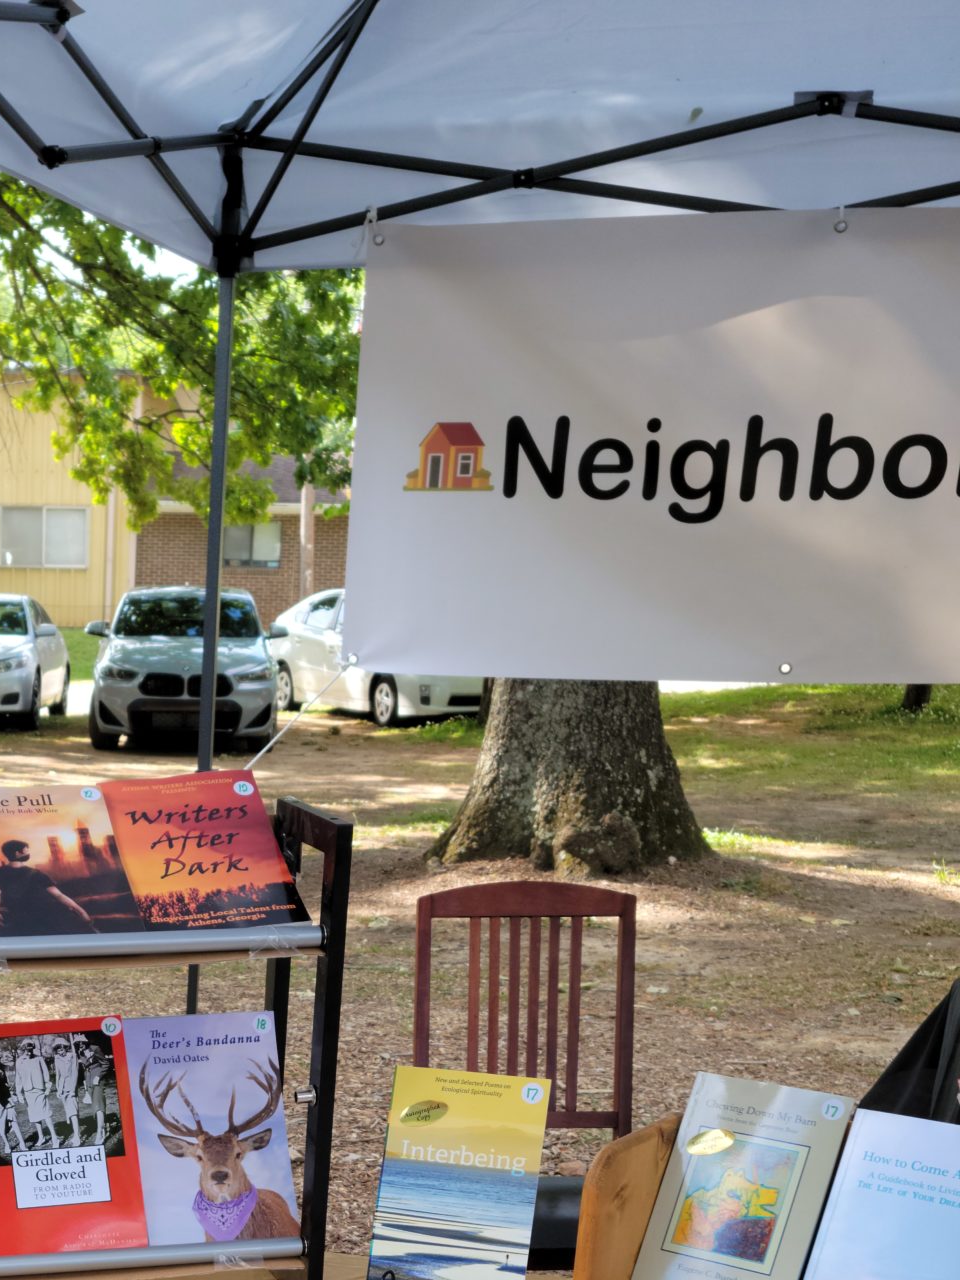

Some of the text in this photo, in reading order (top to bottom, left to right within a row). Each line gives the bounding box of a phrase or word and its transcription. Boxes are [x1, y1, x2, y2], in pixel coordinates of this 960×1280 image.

[502, 413, 960, 524] Neighbo
[16, 793, 54, 807] Pull
[124, 804, 249, 825] Writers
[150, 829, 240, 860] After
[160, 853, 249, 879] Dark
[150, 903, 296, 923] Showcasing Local Talent from
[227, 912, 267, 924] Georgia
[104, 1022, 117, 1033] 10
[256, 1017, 267, 1030] 18
[149, 1029, 167, 1039] The
[196, 1034, 261, 1047] Bandanna
[153, 1053, 210, 1065] David Oates
[461, 1079, 483, 1087] Selected
[484, 1081, 502, 1089] Poems
[441, 1086, 503, 1098] Ecological Spirituality
[526, 1087, 539, 1101] 17
[824, 1103, 839, 1117] 17
[794, 1114, 817, 1127] Barn
[16, 1148, 103, 1168] Girdled and
[401, 1139, 527, 1177] Interbeing
[863, 1150, 949, 1176] How to Come
[35, 1165, 87, 1182] Gloved
[877, 1173, 924, 1188] Guidebook
[33, 1182, 92, 1193] FROM RADIO
[51, 1189, 93, 1199] YOUTUBE
